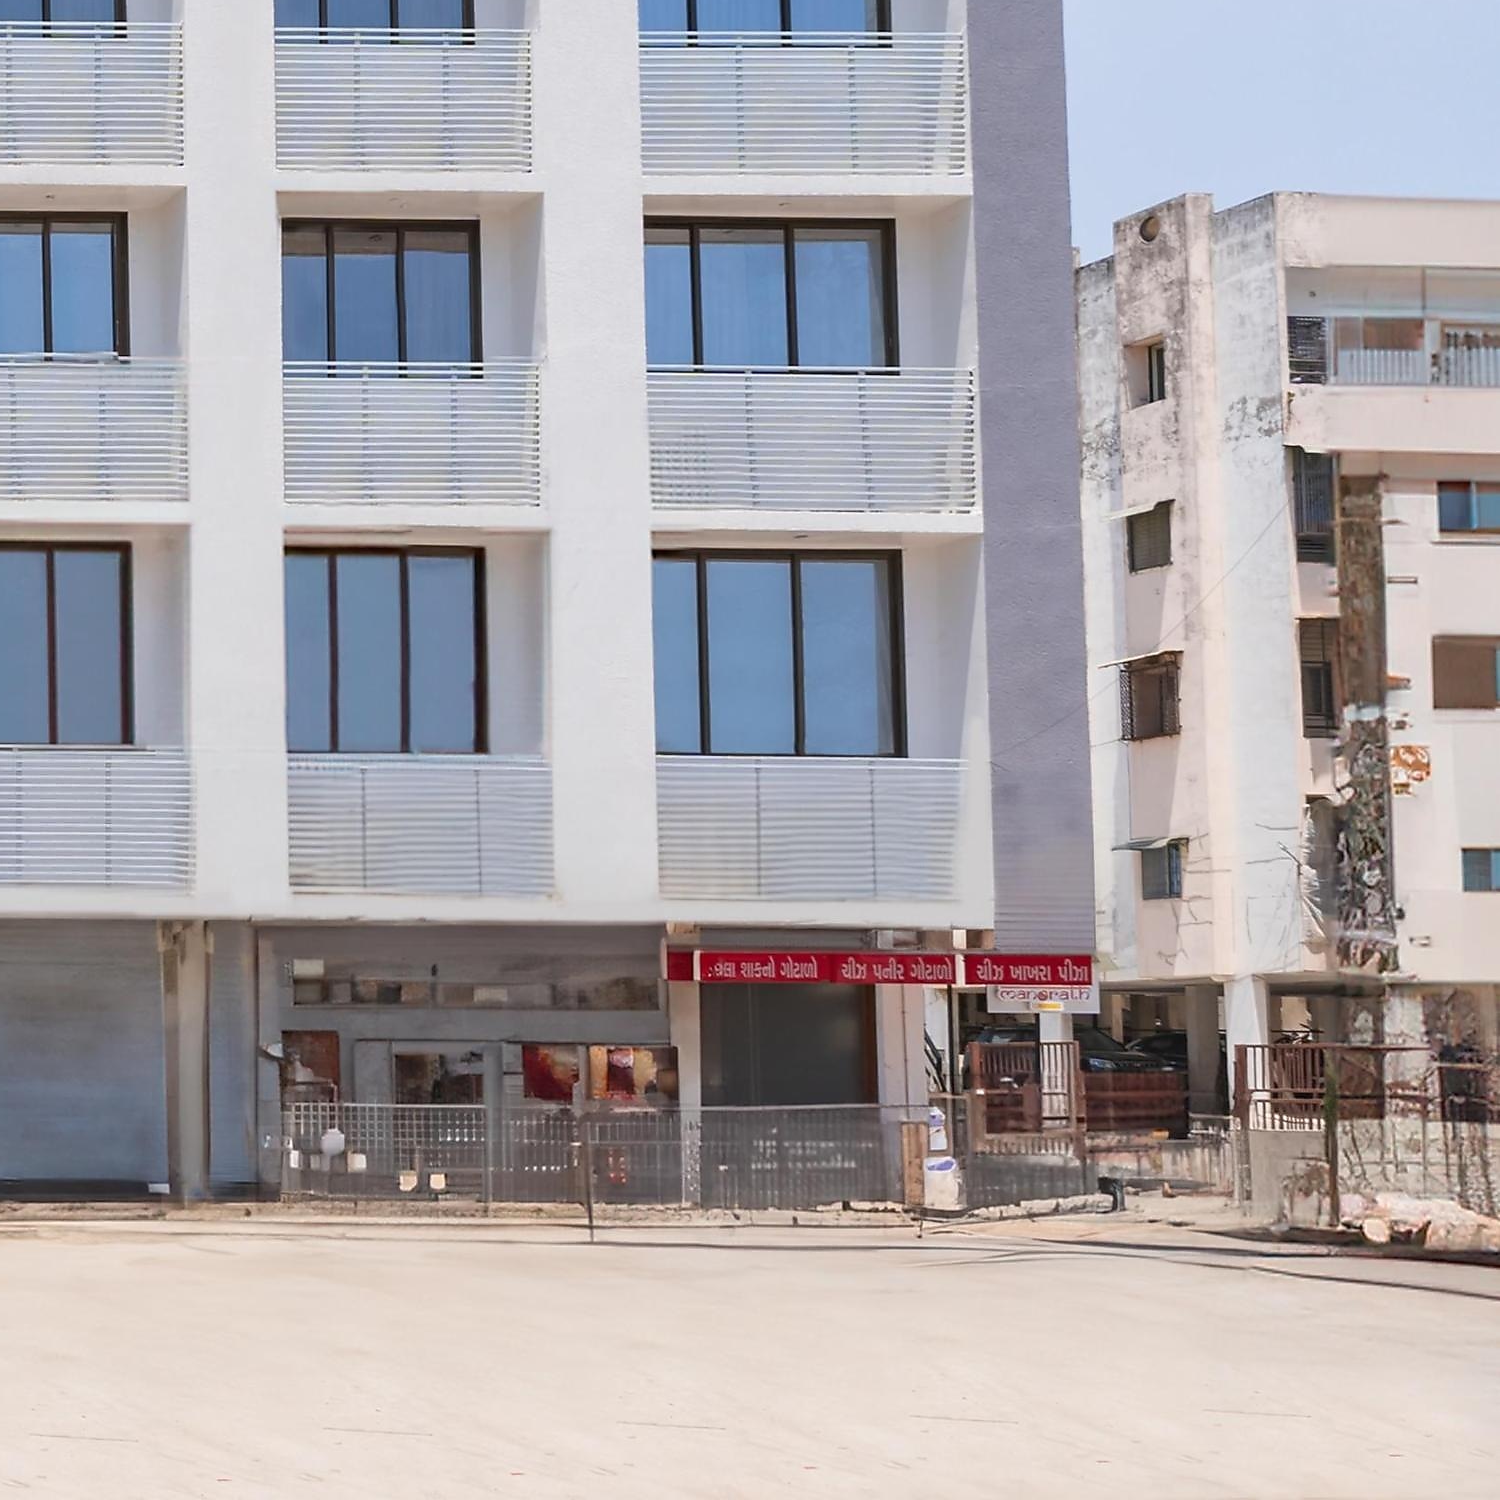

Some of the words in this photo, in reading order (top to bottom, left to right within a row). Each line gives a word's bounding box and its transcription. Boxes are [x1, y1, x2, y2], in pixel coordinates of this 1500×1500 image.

[841, 956, 867, 979] ચીઝ
[873, 957, 904, 980] પનીર
[976, 958, 1004, 981] ચીઝ
[1009, 965, 1051, 981] ખાખરા
